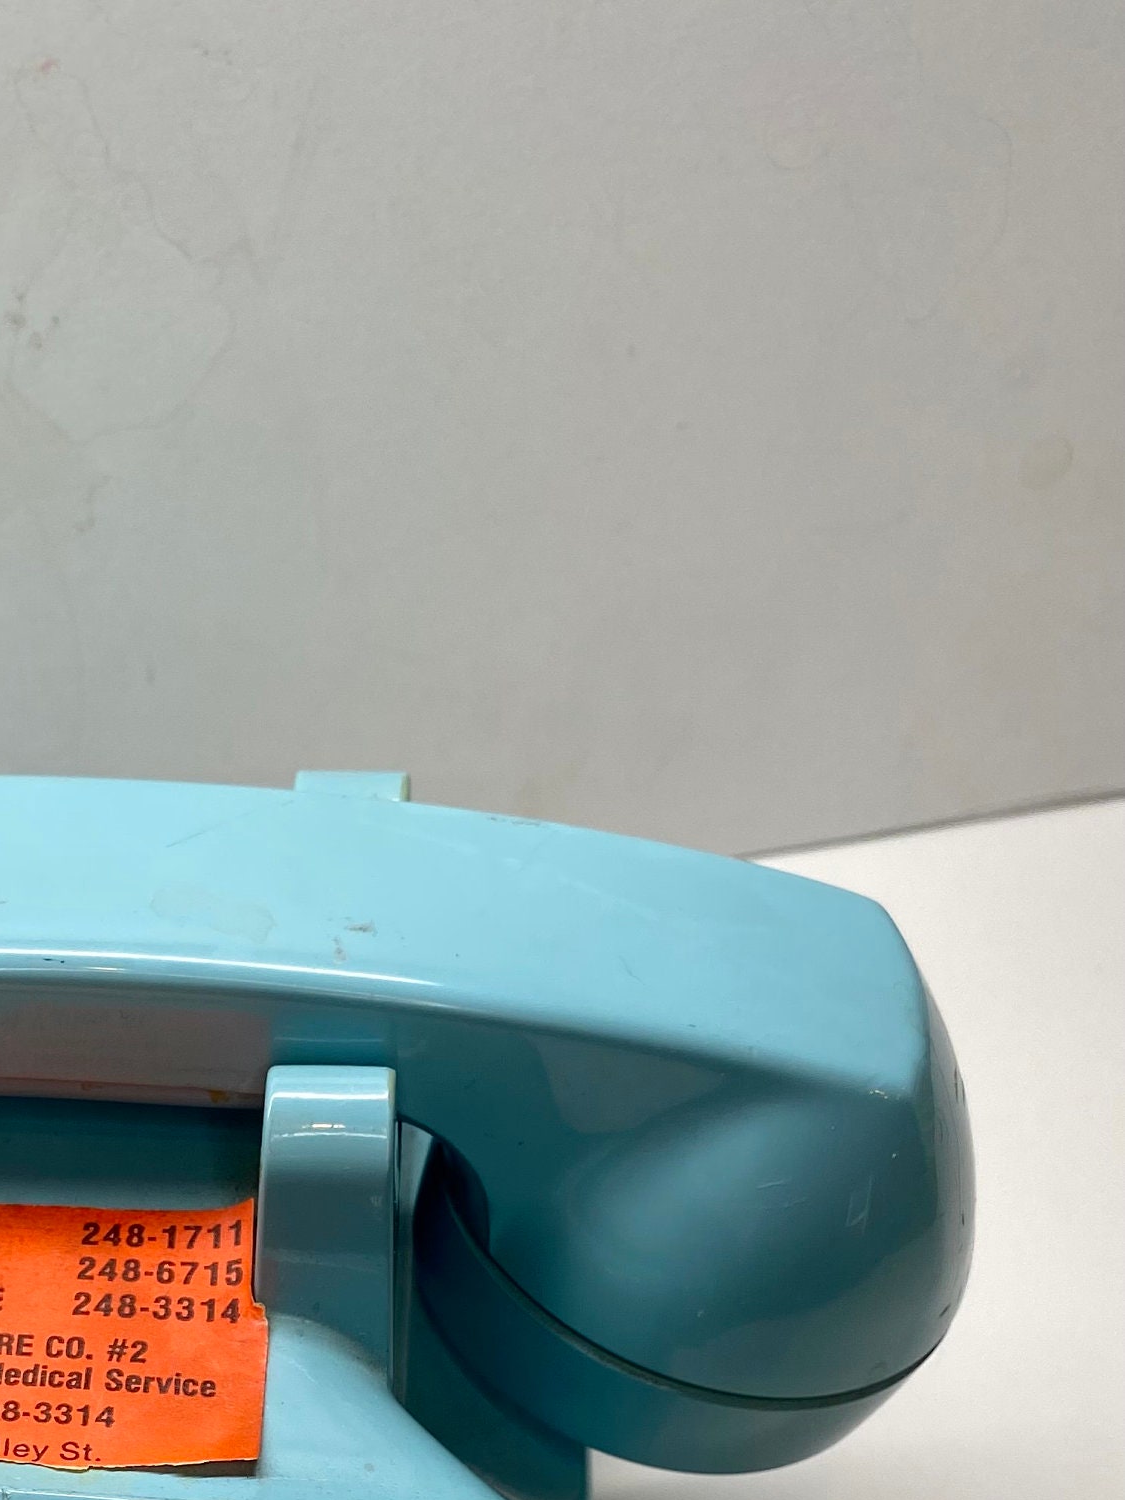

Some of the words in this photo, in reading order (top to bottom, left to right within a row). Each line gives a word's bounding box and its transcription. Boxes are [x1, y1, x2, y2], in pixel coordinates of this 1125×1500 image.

[81, 1220, 243, 1249] 248-1711
[76, 1256, 244, 1286] 248-6715
[72, 1292, 241, 1324] 248-3314
[45, 1336, 93, 1361] CO.
[107, 1338, 148, 1363] #2
[104, 1368, 217, 1398] Service
[59, 1441, 101, 1461] St.
